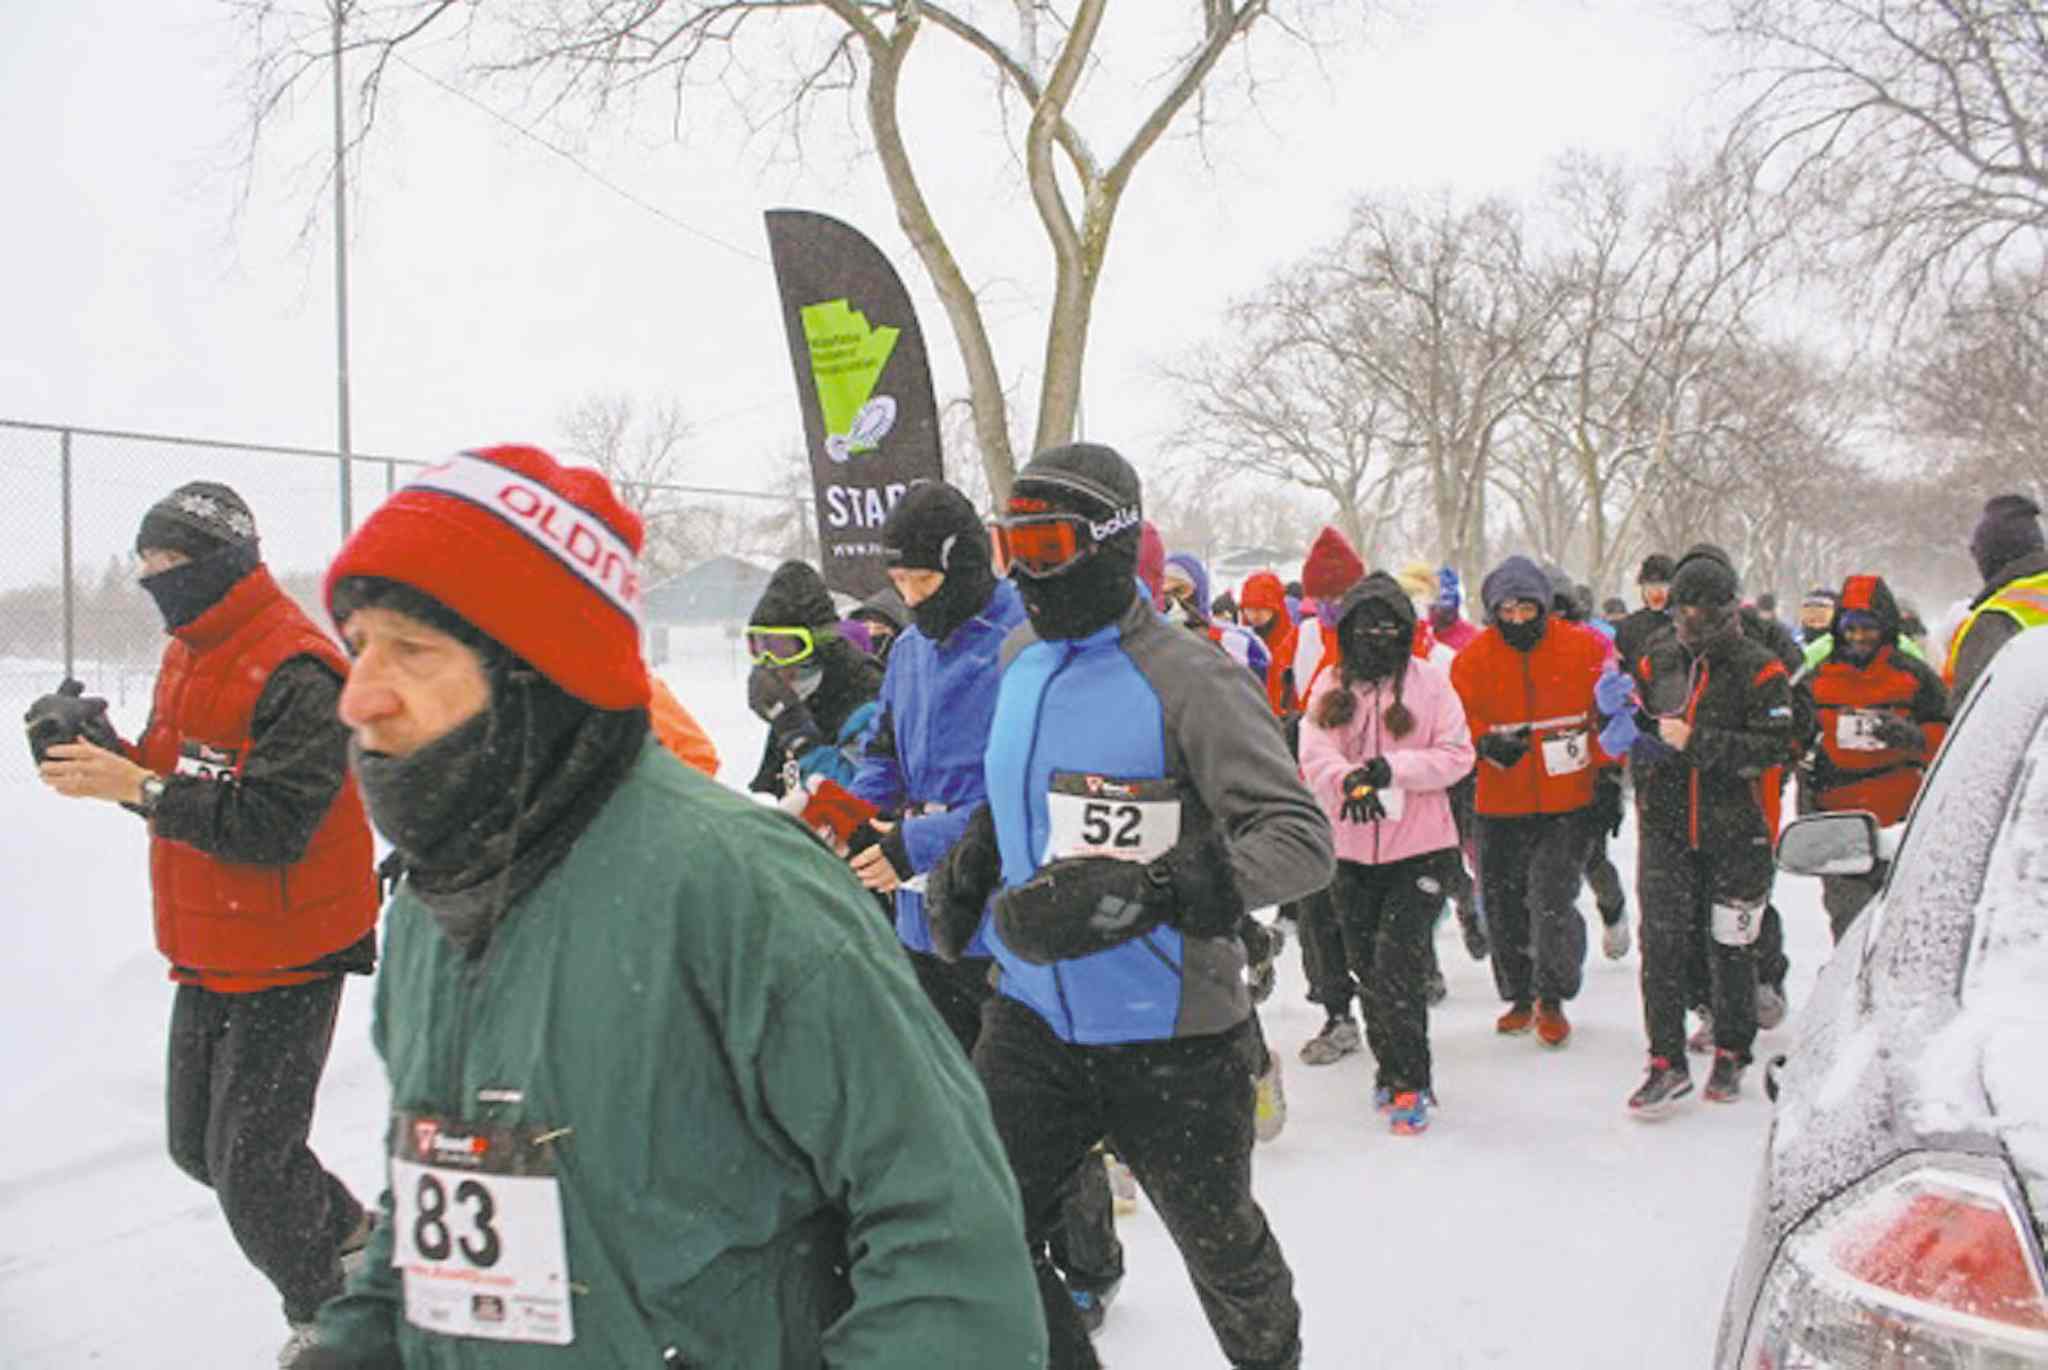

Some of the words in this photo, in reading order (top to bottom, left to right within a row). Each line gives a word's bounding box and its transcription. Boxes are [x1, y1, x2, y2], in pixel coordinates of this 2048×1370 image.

[1567, 736, 1579, 758] 6
[1083, 803, 1142, 847] 52
[1738, 913, 1751, 931] 9
[416, 1174, 501, 1267] 83
